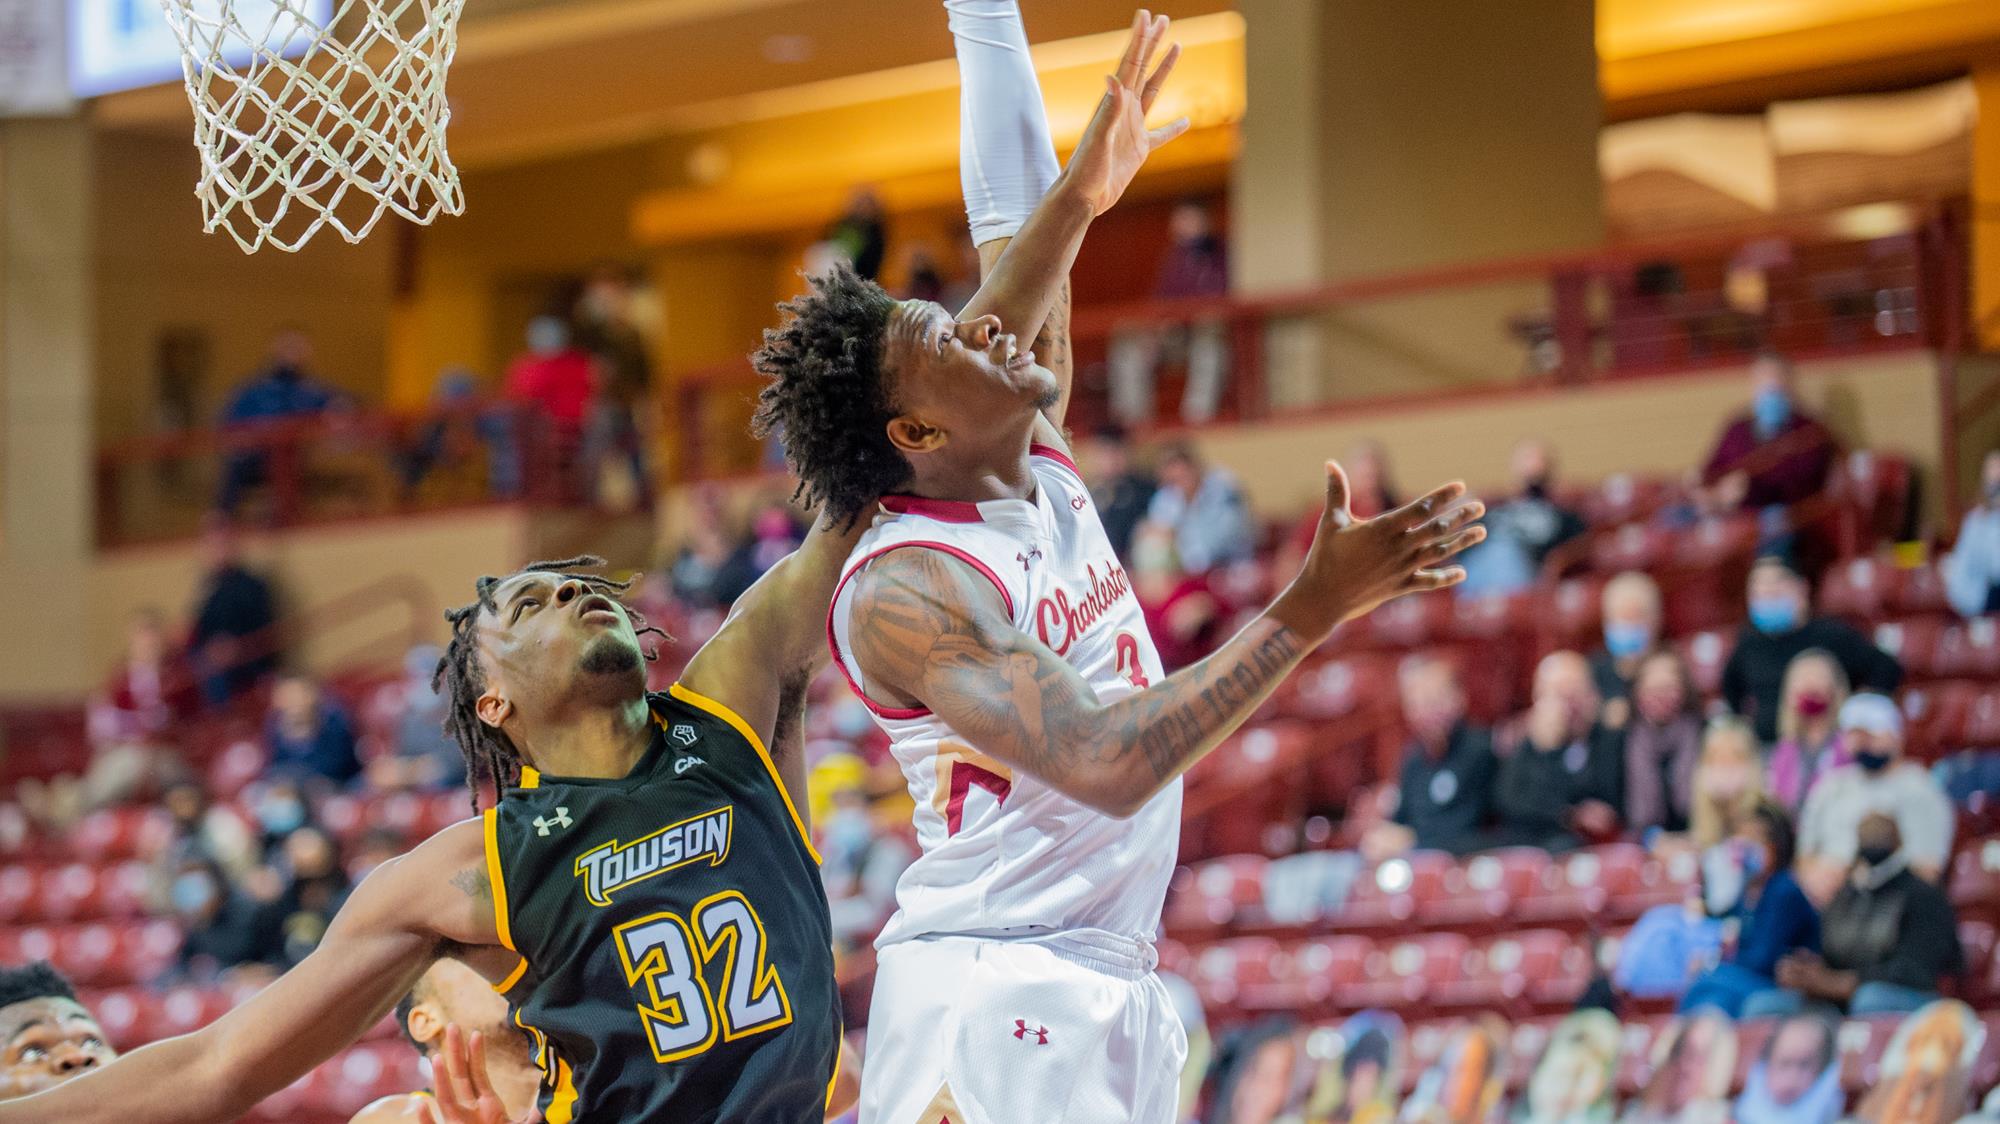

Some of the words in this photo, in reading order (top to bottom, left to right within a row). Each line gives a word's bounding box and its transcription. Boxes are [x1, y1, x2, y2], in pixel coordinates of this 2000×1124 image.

[1071, 494, 1087, 511] CA
[1036, 559, 1130, 657] Charlesto
[576, 806, 731, 906] TOWSON
[613, 890, 792, 1063] 32
